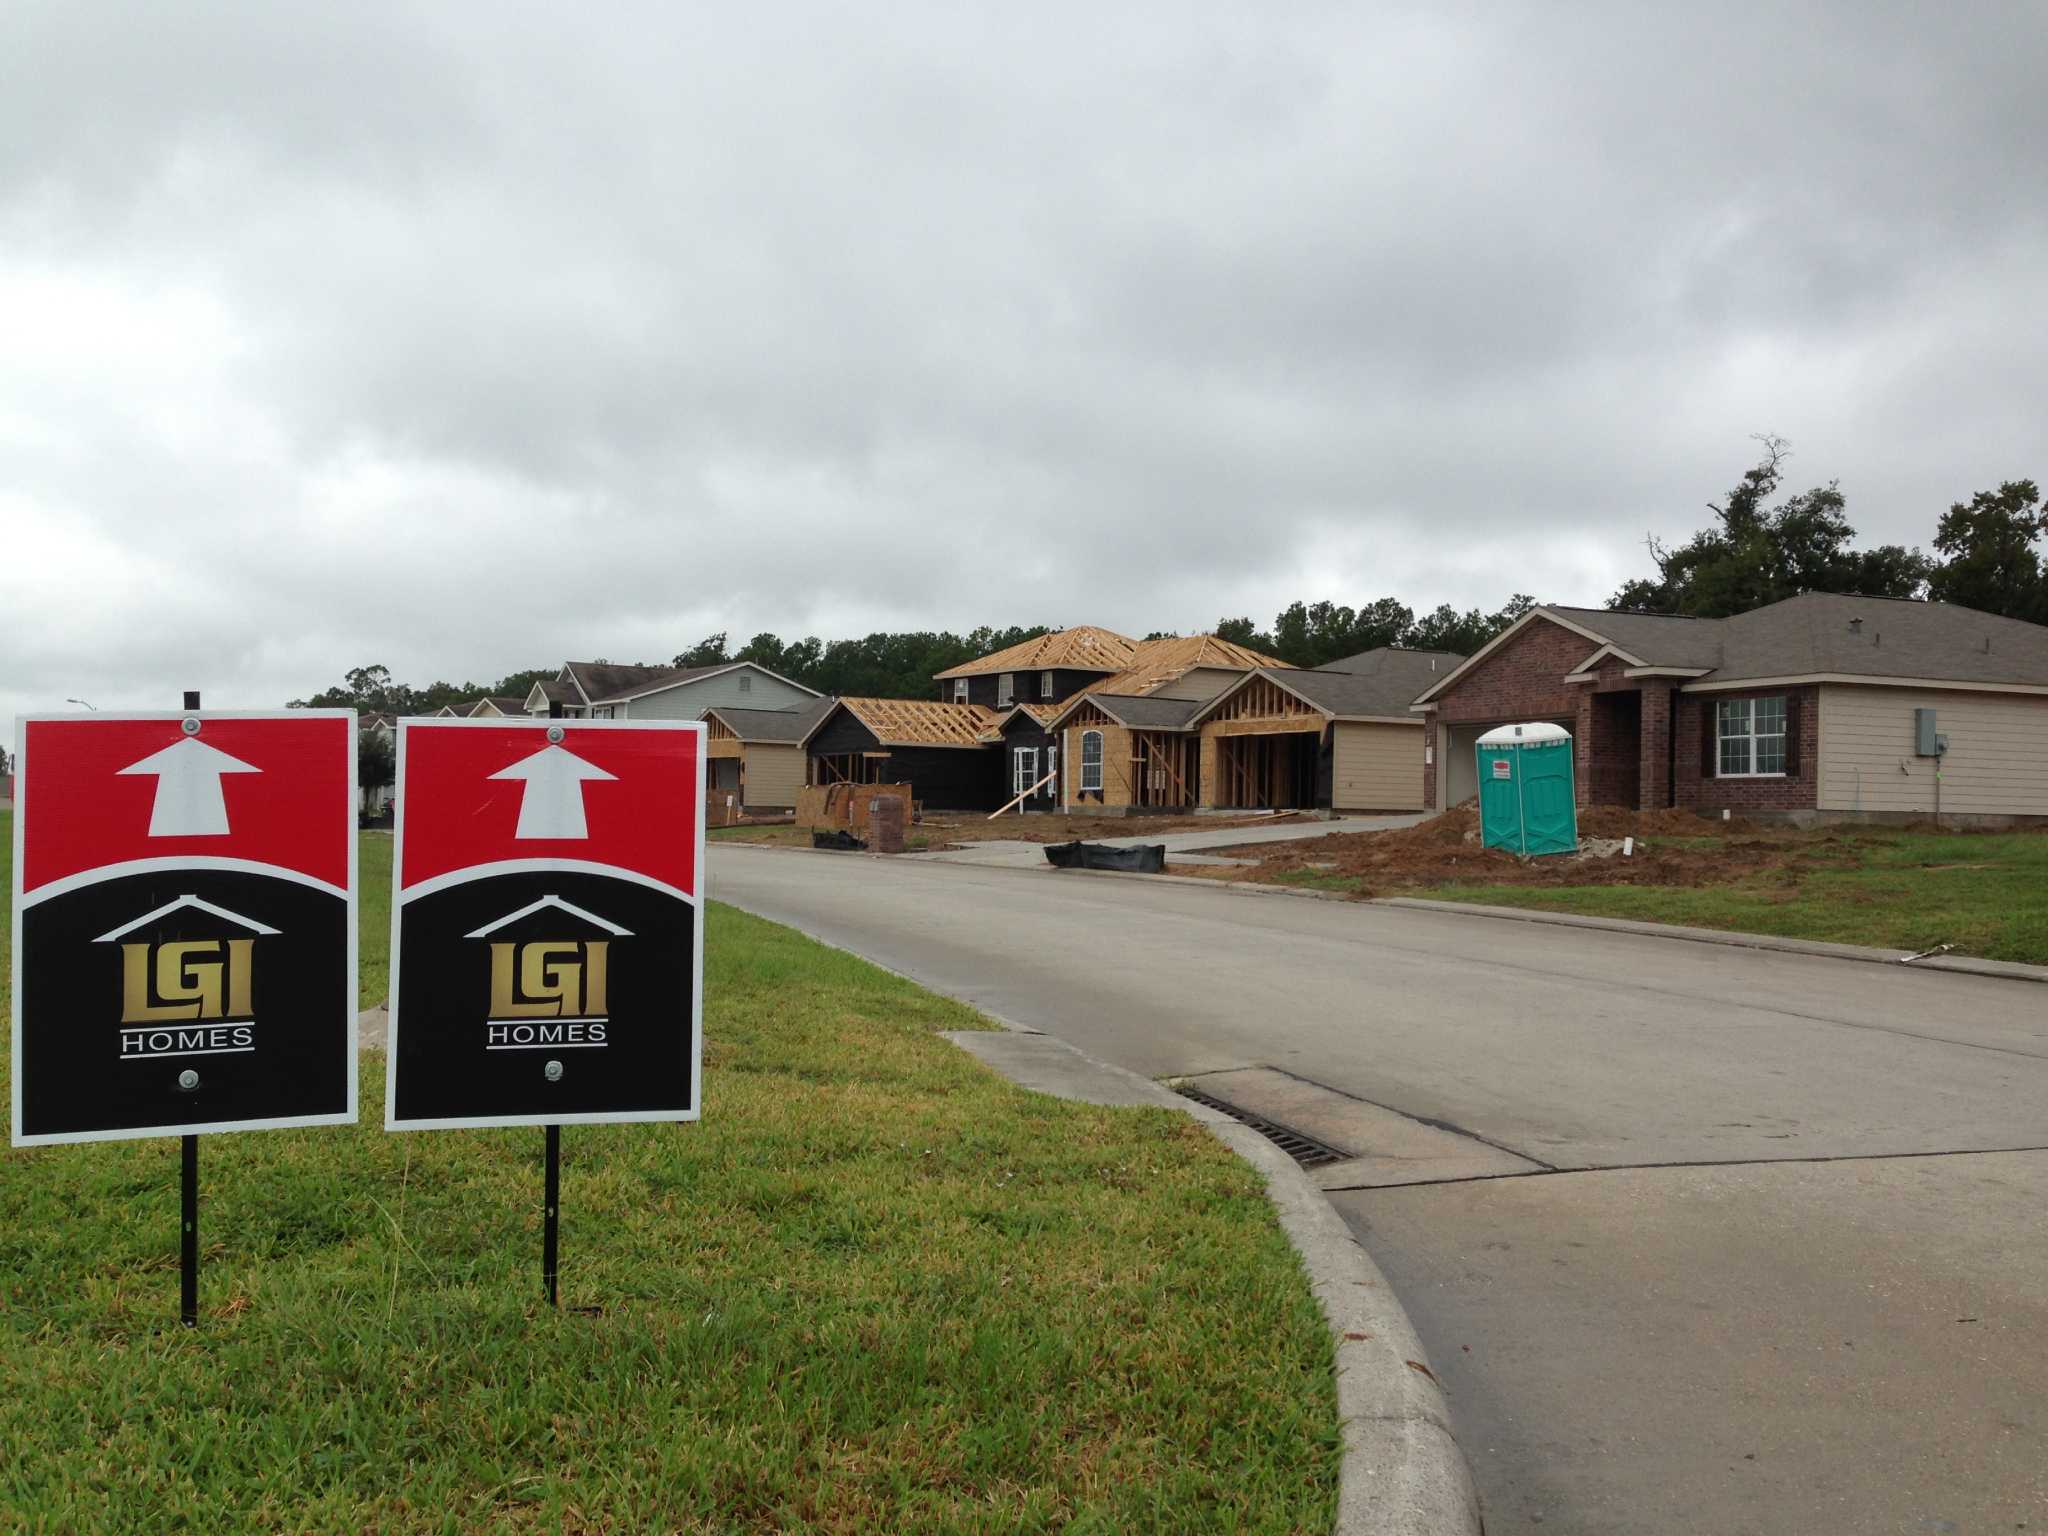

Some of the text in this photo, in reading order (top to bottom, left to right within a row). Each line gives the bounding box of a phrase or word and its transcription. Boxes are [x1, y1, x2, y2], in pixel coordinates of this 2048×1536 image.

[121, 939, 255, 1022] LGI
[488, 941, 609, 1018] LGI
[122, 1027, 253, 1053] HOMES
[489, 1024, 606, 1044] HOMES
